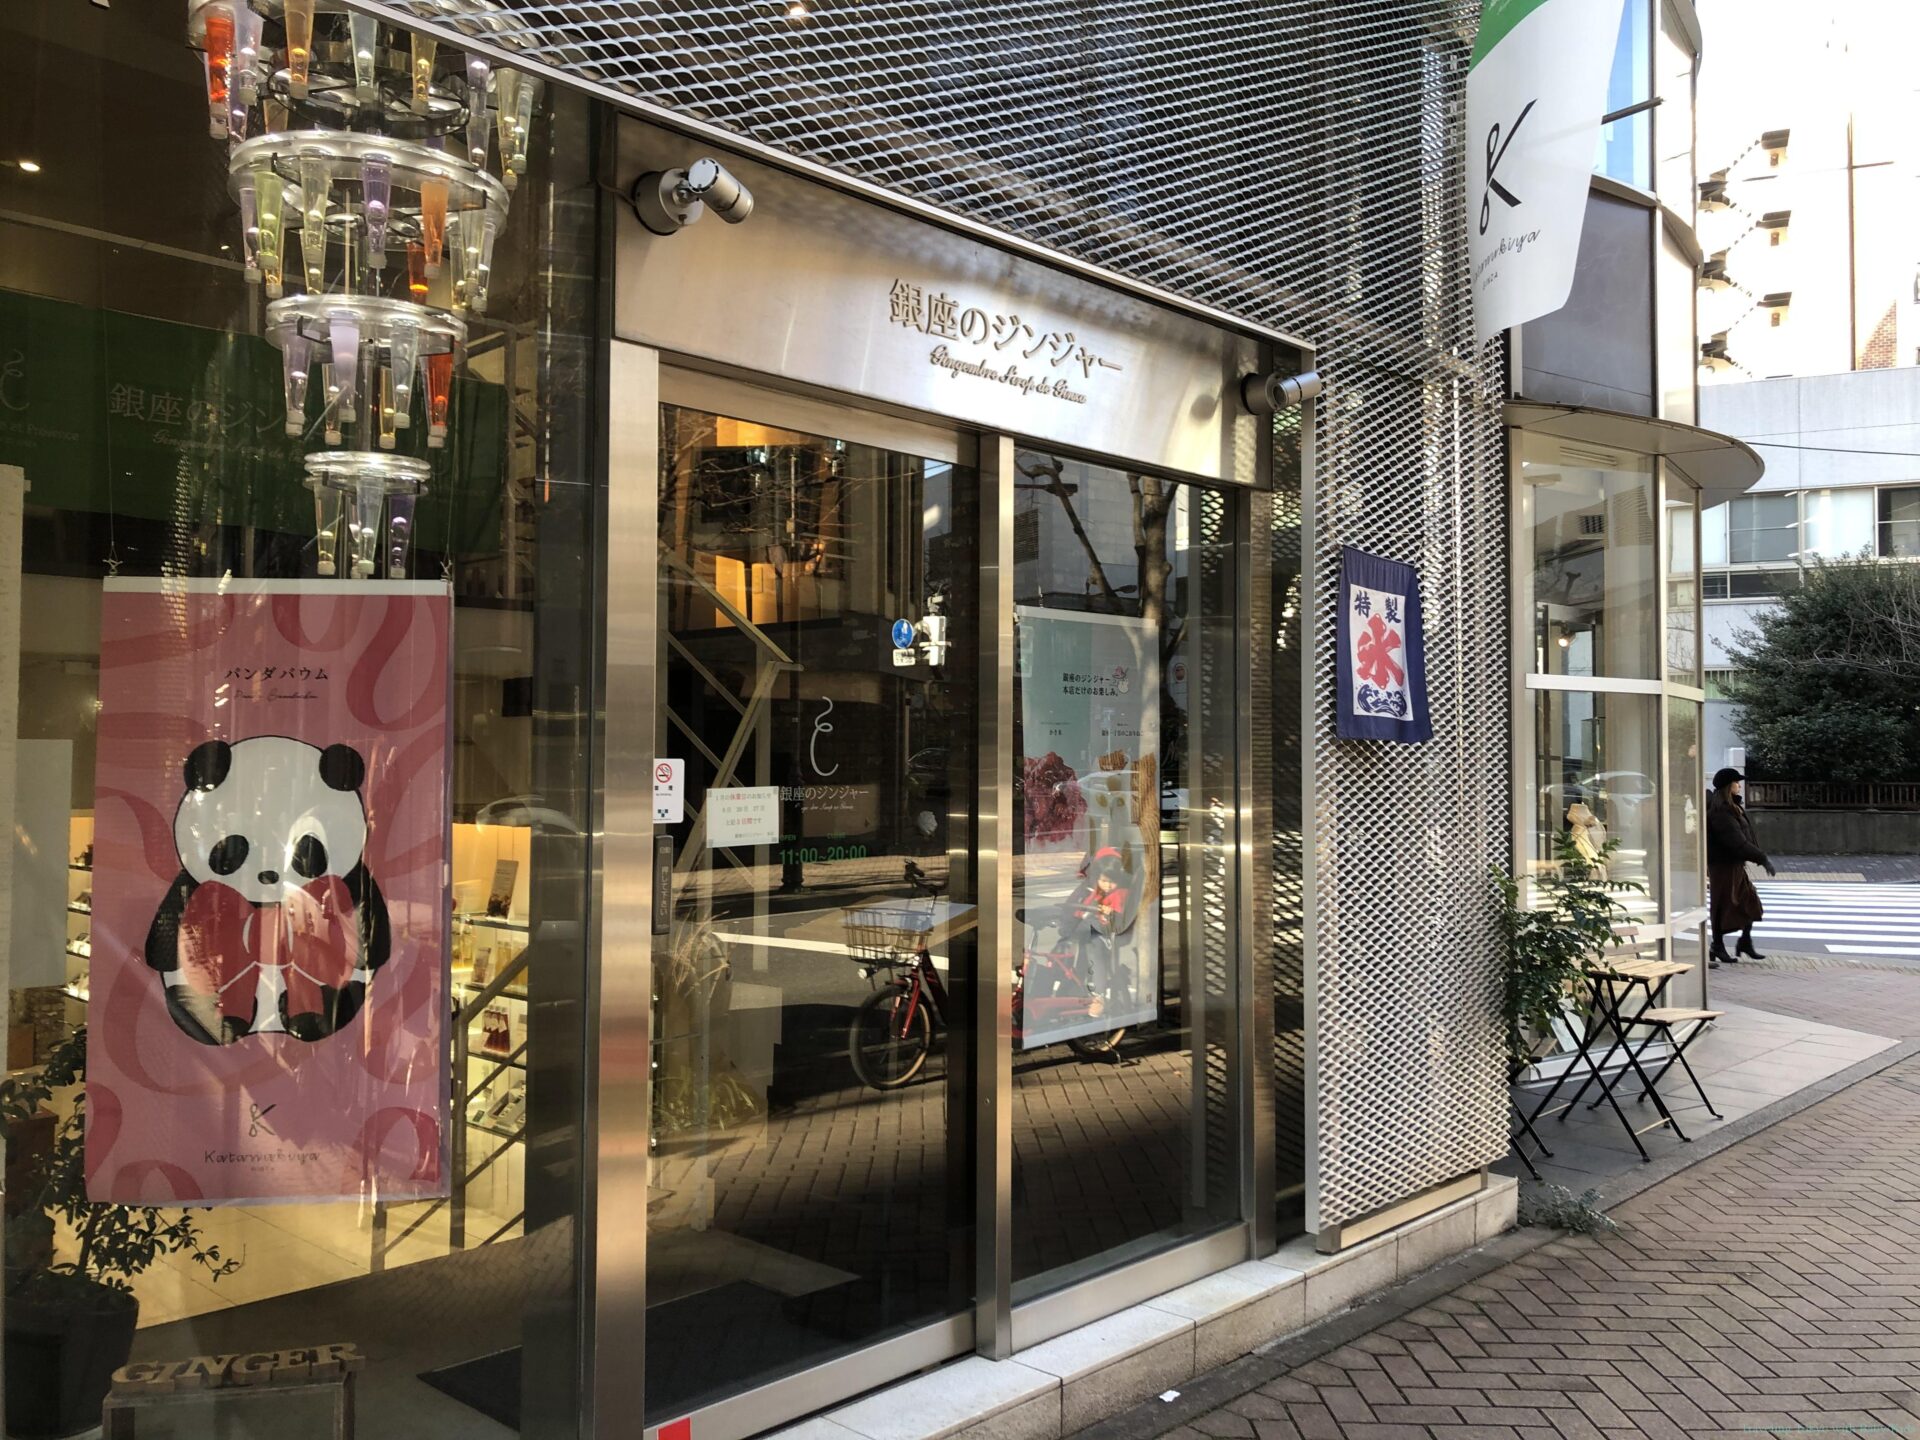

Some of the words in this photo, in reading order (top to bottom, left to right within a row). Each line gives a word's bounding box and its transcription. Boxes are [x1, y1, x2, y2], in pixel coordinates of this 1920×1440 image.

[889, 277, 1123, 379] 銀座のジンジャー
[1354, 590, 1402, 624] 特製
[1356, 612, 1405, 690] 氷
[225, 666, 329, 682] パンダバウム
[779, 785, 869, 802] 銀座のジンジャー
[111, 1342, 365, 1390] GINGER
